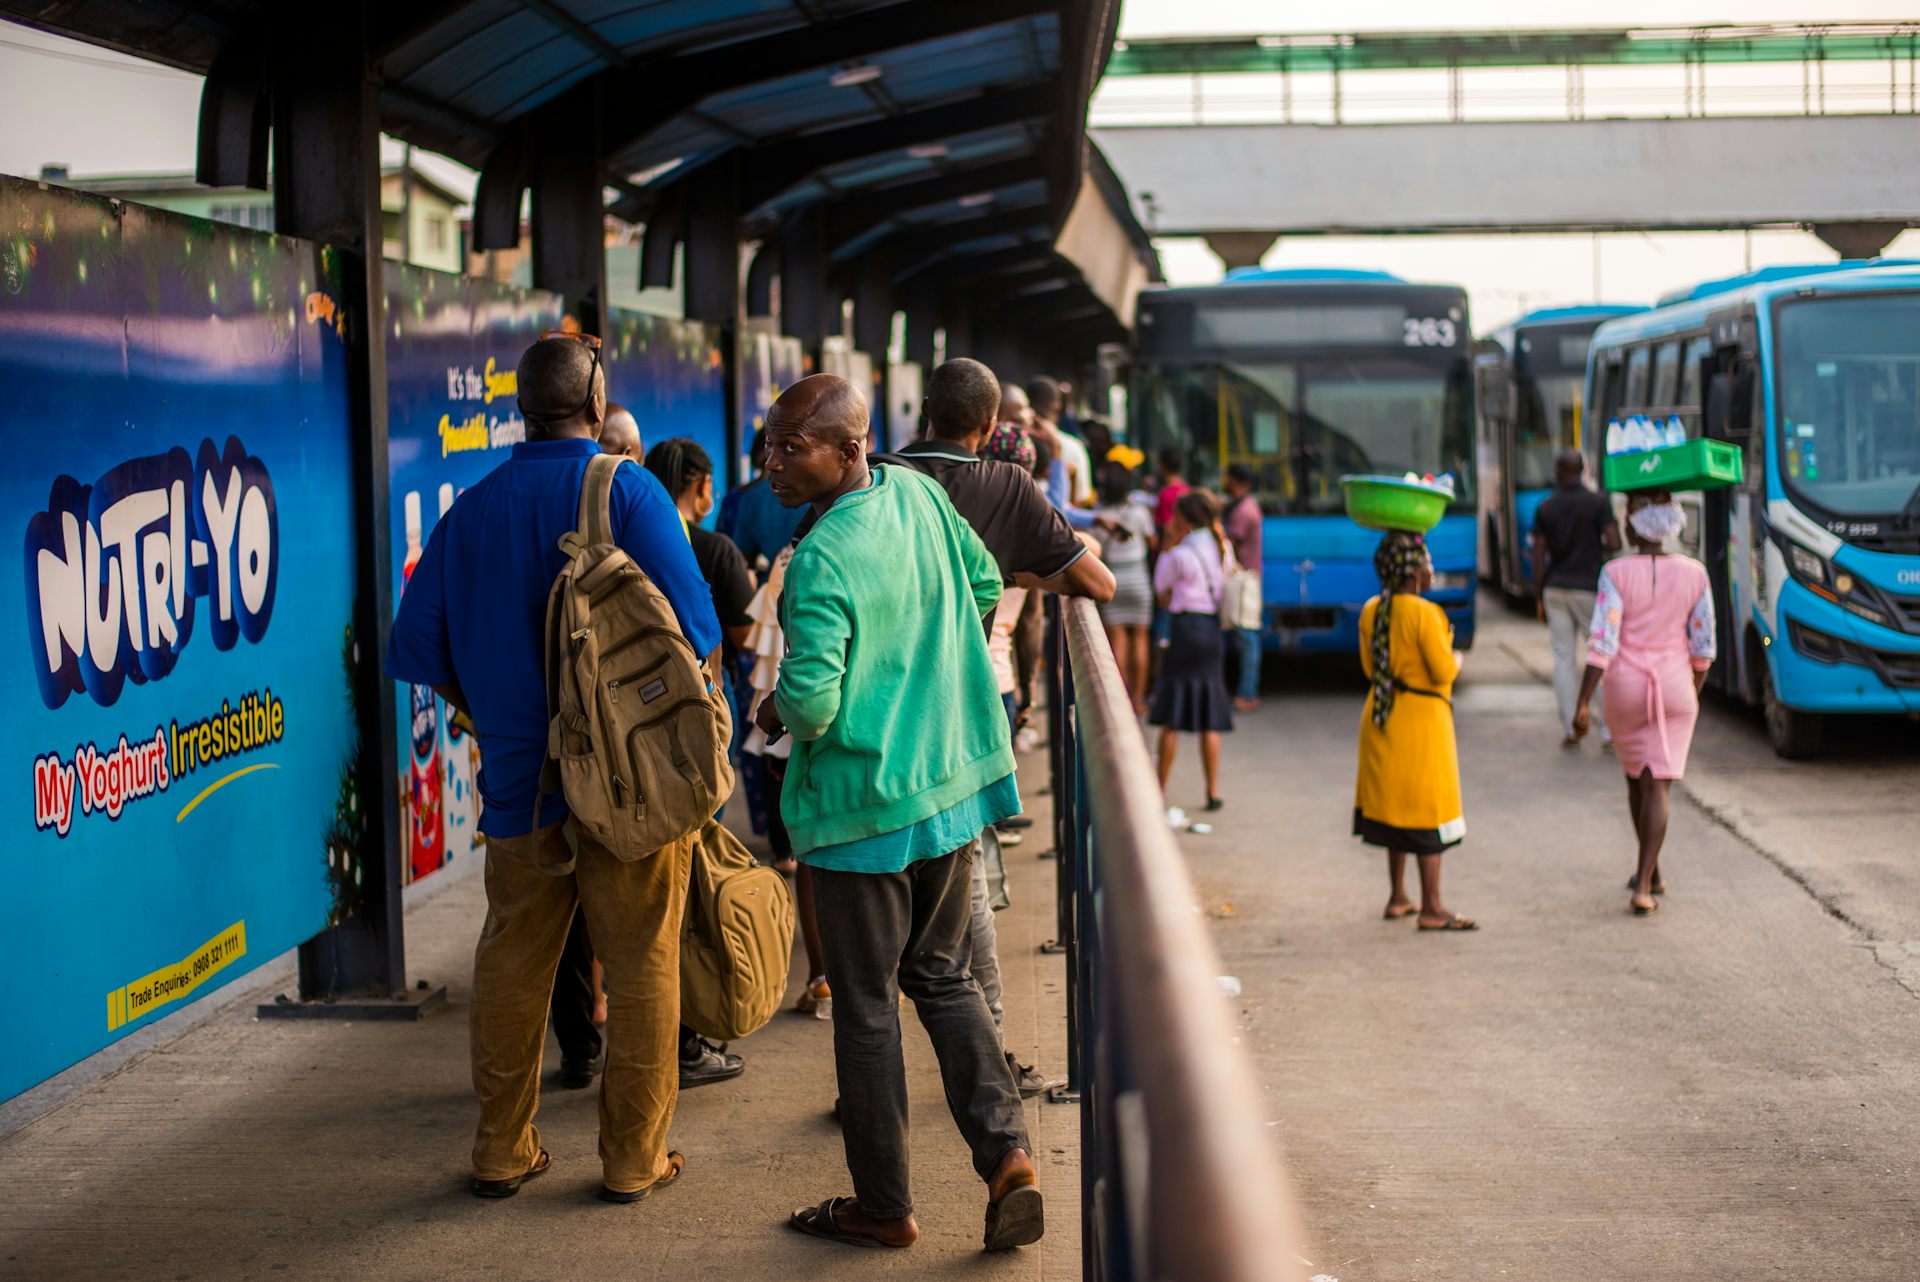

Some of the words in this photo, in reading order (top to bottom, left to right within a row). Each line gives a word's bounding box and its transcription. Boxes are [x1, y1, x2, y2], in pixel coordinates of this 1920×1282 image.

[1402, 318, 1456, 347] 263
[447, 366, 465, 400] It's
[465, 366, 483, 400] the
[37, 464, 270, 673] NUTRI-YO
[35, 754, 75, 834] My
[77, 728, 168, 817] Yoghurt
[171, 690, 283, 777] Irresistible
[131, 986, 152, 1009] Trade
[154, 969, 191, 998] Enquiries:
[193, 953, 209, 977] 0908
[211, 943, 222, 964] 321
